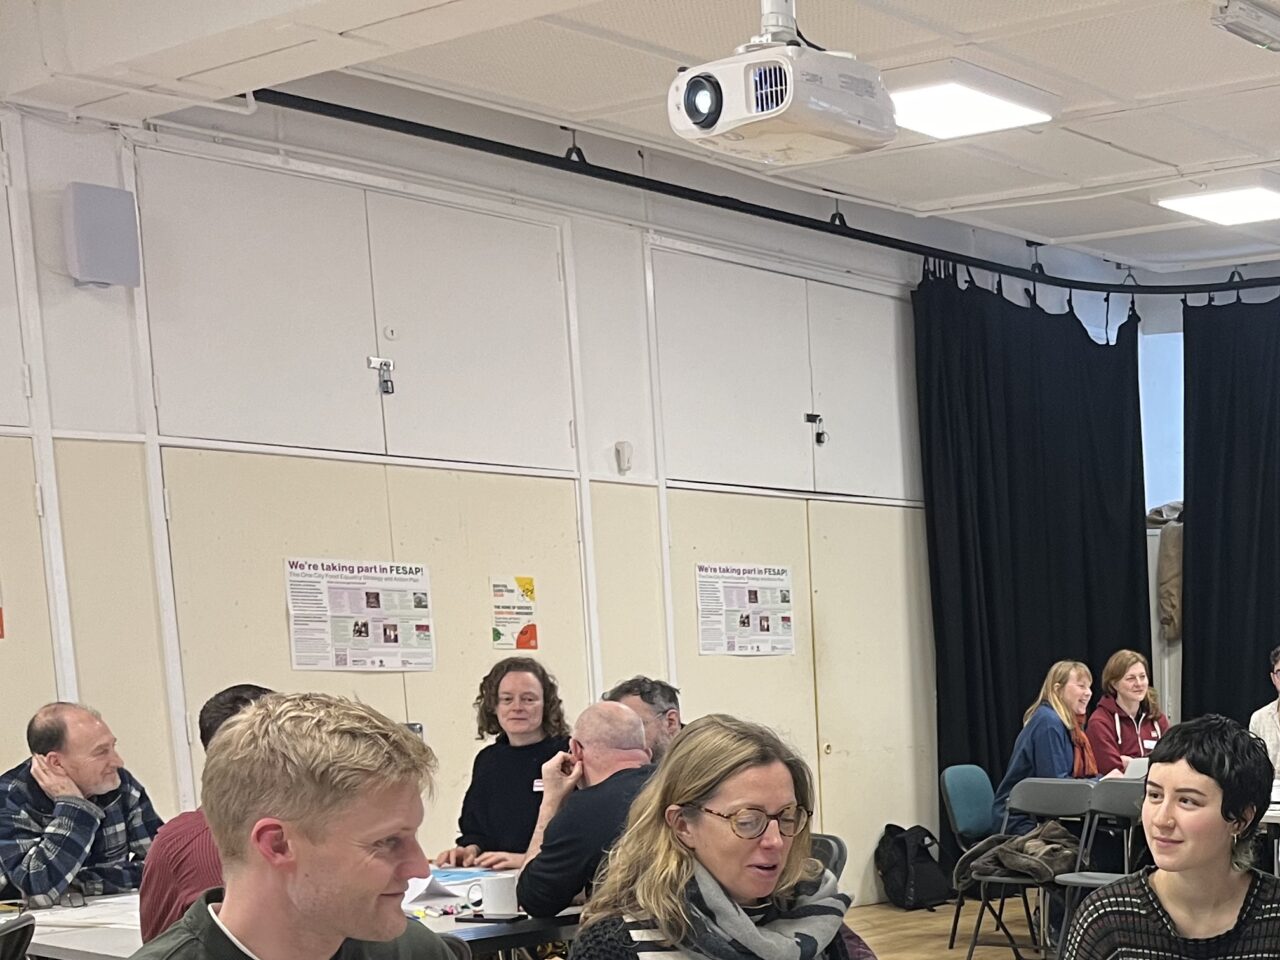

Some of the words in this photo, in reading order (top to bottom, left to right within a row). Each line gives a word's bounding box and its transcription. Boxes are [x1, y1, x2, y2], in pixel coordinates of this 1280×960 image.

[288, 561, 319, 571] We're
[321, 562, 355, 574] taking
[357, 564, 378, 575] part
[379, 564, 388, 574] in
[389, 565, 424, 576] FESAP!
[697, 565, 718, 573] We're
[719, 566, 741, 576] taking
[742, 568, 756, 576] part
[757, 567, 763, 575] in
[764, 568, 788, 576] FESAP!
